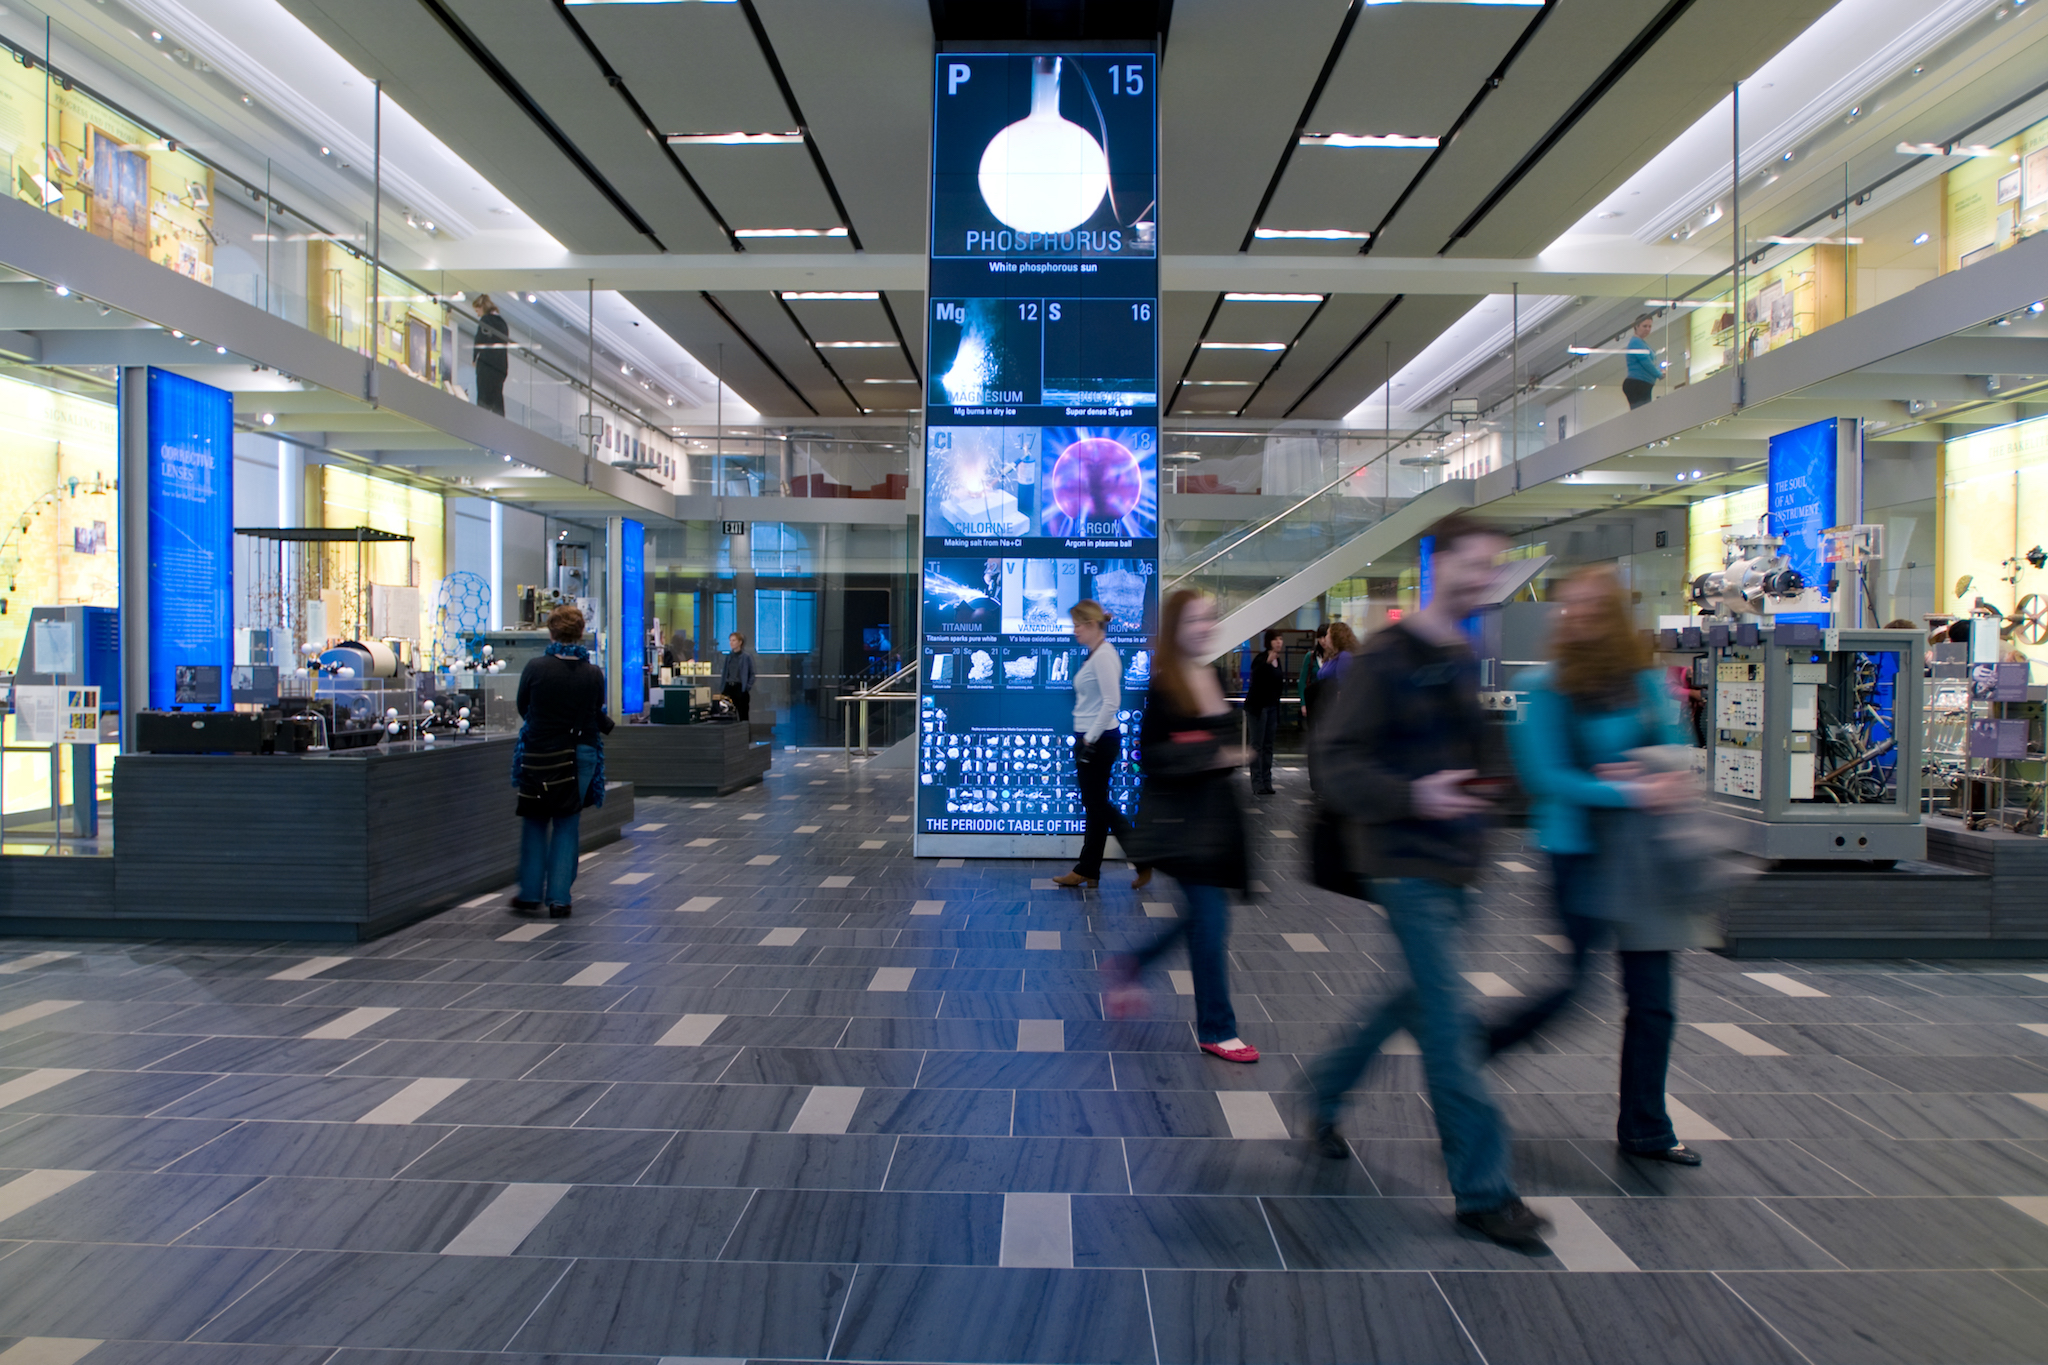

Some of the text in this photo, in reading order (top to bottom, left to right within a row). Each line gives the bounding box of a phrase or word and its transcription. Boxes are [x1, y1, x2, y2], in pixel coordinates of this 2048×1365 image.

[948, 63, 972, 95] P
[1108, 64, 1144, 95] 15
[966, 230, 1122, 251] PHOSPHORUS
[989, 262, 1098, 274] White phosphorous sun
[936, 302, 966, 324] Mg
[1018, 303, 1038, 321] 12
[1049, 302, 1062, 321] S
[1131, 303, 1150, 321] 16
[948, 391, 1023, 402] MAGNESIUM
[954, 407, 1017, 416] Mg burns in dry ice
[1066, 407, 1086, 417] Super
[1087, 408, 1107, 416] dense
[1120, 409, 1133, 417] gas
[44, 407, 96, 431] SIGNALING
[934, 432, 952, 449] Cl
[1017, 432, 1036, 450] 17
[1132, 432, 1150, 450] 18
[161, 444, 216, 470] CORRECTIVE
[161, 462, 194, 482] LENSES
[1775, 475, 1808, 493] THE SOUL
[1774, 493, 1795, 508] OF AN
[1774, 502, 1820, 522] INSTRUMENT
[725, 522, 743, 533] EXIT
[954, 522, 1014, 534] CHLORINE
[1077, 522, 1120, 534] ARGON
[944, 538, 1022, 549] Making salt from Na+Cl
[1065, 539, 1133, 549] Argon in plasma ball
[928, 561, 941, 574] Ti
[984, 562, 998, 574] 22
[1006, 562, 1016, 574] V
[1062, 563, 1076, 575] 23
[1083, 562, 1098, 575] Fe
[1138, 563, 1153, 575] 26
[942, 622, 983, 632] TITANIUM
[1018, 624, 1063, 633] VANADIUM
[1108, 625, 1128, 633] IRON
[926, 634, 997, 644] Titanium sparks pure white
[1019, 635, 1030, 643] blue
[1031, 635, 1055, 643] oxidation
[1056, 635, 1071, 643] state
[952, 647, 960, 655] 20
[1031, 648, 1039, 656] 24
[926, 818, 1086, 833] THE PERIODIC TABLE OF THE
